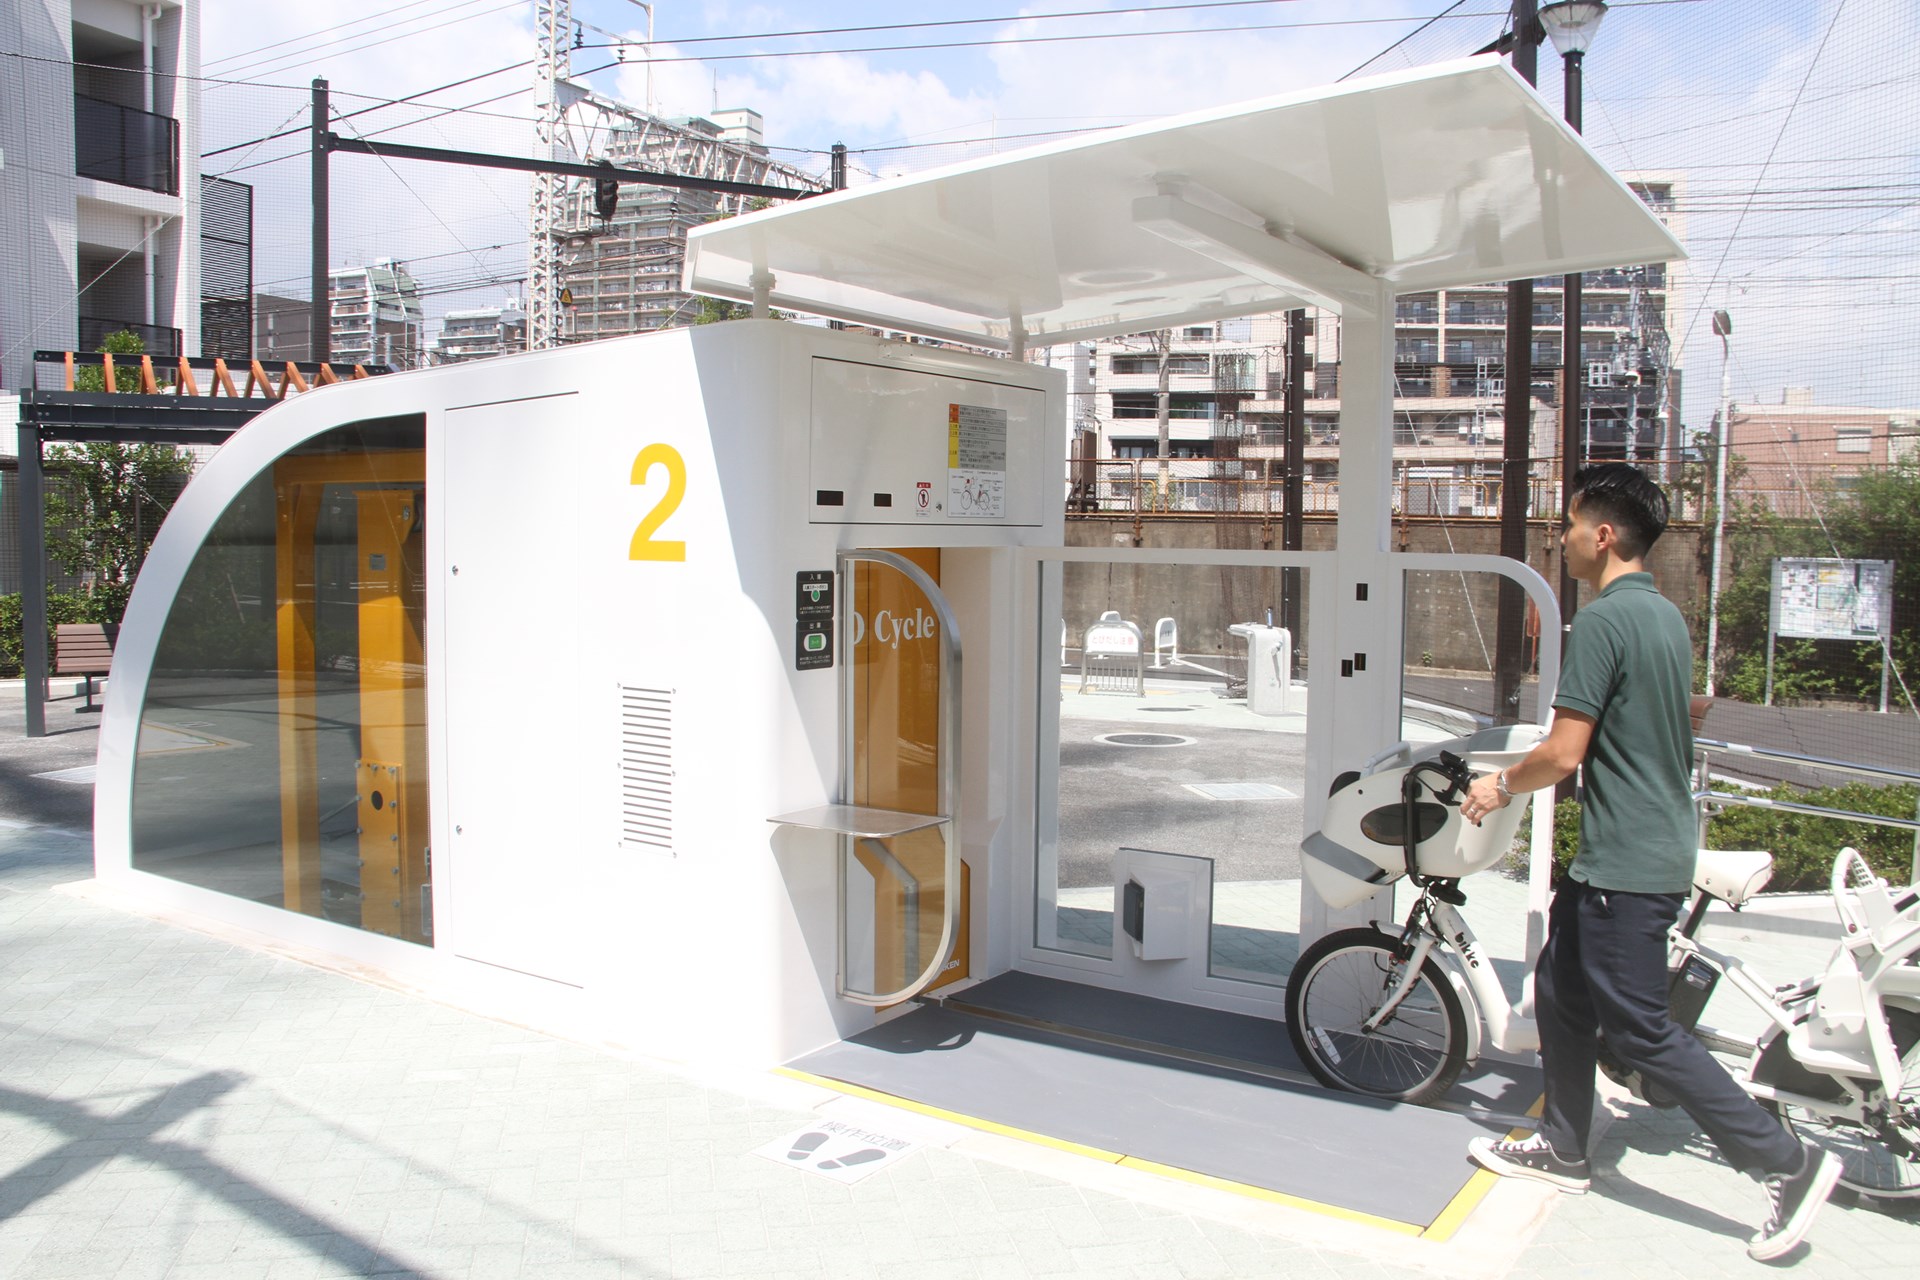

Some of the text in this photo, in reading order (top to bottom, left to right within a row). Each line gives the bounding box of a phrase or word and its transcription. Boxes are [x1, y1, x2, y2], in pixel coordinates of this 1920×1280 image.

[629, 442, 687, 562] 2
[874, 607, 935, 650] Cycle
[1454, 931, 1479, 969] bikke
